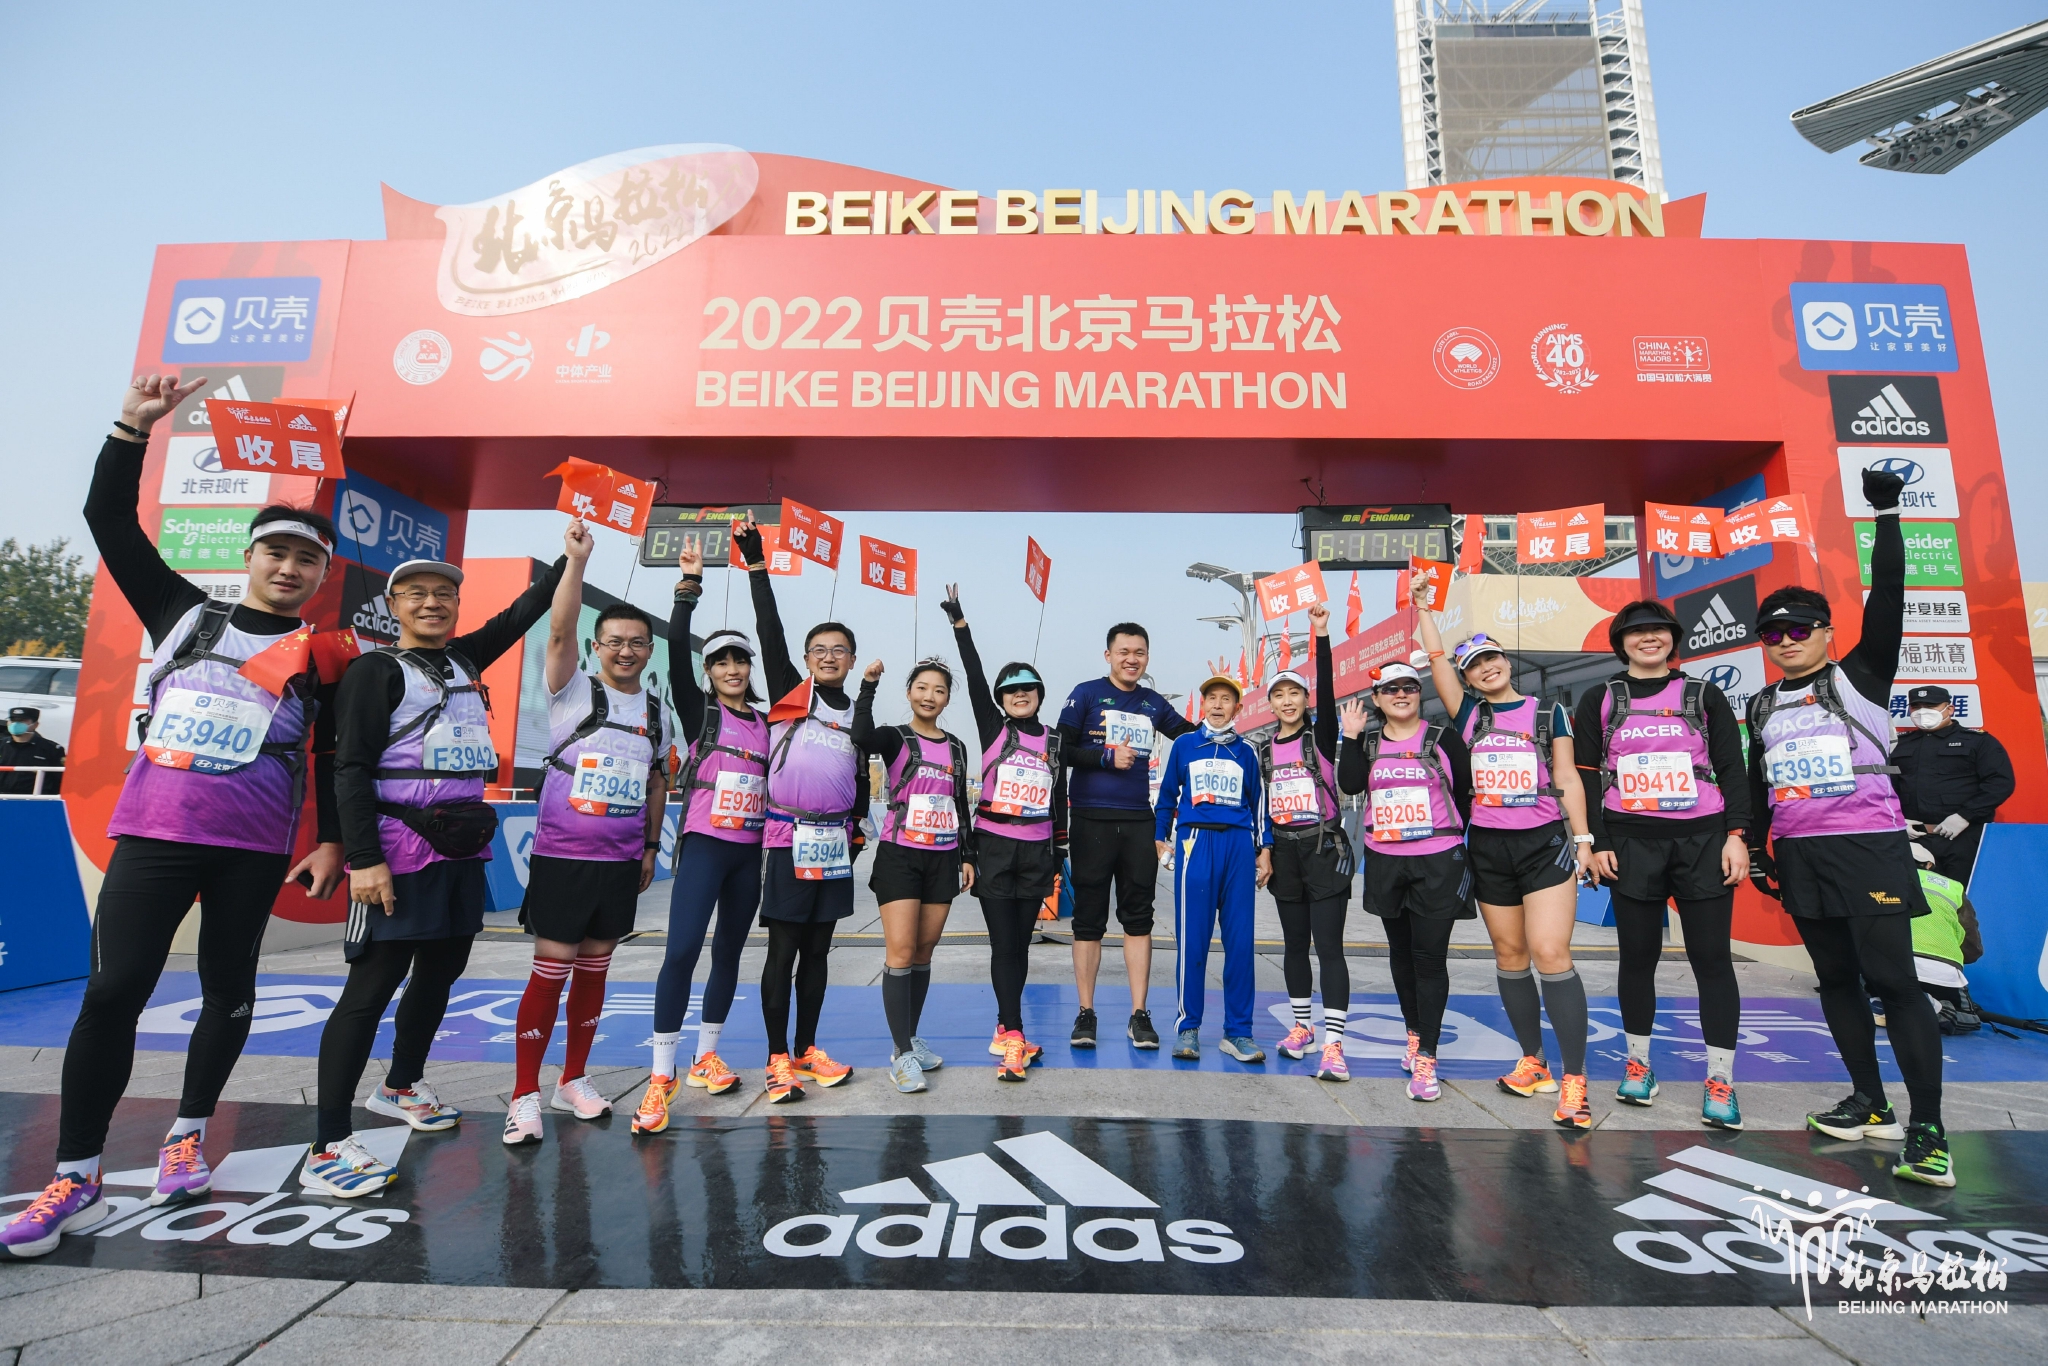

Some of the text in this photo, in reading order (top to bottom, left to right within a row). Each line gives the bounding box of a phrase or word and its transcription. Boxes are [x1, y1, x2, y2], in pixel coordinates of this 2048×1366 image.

[472, 162, 709, 274] 北京马拉松
[785, 188, 1665, 238] BEIKE BEIJING MARATHON
[231, 295, 311, 331] 贝壳
[700, 294, 1343, 354] 2022贝壳北京马拉松
[1864, 303, 1946, 340] 贝壳
[230, 333, 305, 343] 让家更美好
[1545, 333, 1583, 345] AIMS
[1638, 341, 1671, 350] CHINA
[1869, 341, 1947, 353] 让家更美好
[1530, 344, 1544, 374] WORLD
[1545, 344, 1585, 368] 40
[1639, 355, 1672, 363] MAJORS
[556, 364, 613, 378] 中体产业
[1636, 373, 1713, 383] 中国马拉松大满贯
[695, 370, 1347, 410] BEIKE BEIJING MARATHON
[287, 423, 318, 432] adidas
[1851, 416, 1931, 436] adidas
[234, 434, 325, 471] 收尾
[181, 478, 250, 494] 北京现代
[163, 518, 250, 535] Schneider
[1359, 507, 1411, 525] FENGMAO
[199, 534, 248, 544] Electric
[387, 509, 442, 561] 贝壳
[1656, 527, 1712, 553] 收尾
[1729, 517, 1800, 545] 收尾
[1859, 532, 1953, 549] Seider
[788, 526, 832, 563] 收尾
[1317, 532, 1442, 562] 6:17:46
[1528, 532, 1591, 559] 收尾
[868, 561, 907, 591] 收尾
[1863, 563, 1959, 575] 施德电气
[197, 584, 242, 598] 夏基金
[1269, 584, 1318, 615] 收尾
[1903, 602, 1962, 616] 华夏基金
[1688, 623, 1748, 650] adidas
[1922, 665, 1968, 674] JEWELLERY
[157, 713, 253, 754] F3940
[804, 729, 858, 756] PACE
[1111, 724, 1149, 744] F2967
[1475, 735, 1528, 748] PACER
[1620, 724, 1684, 742] PACER
[433, 746, 495, 770] F3942
[584, 734, 651, 760] PACER
[918, 767, 954, 783] PACE
[1272, 767, 1308, 781] ACER
[1373, 767, 1427, 781] PACER
[1475, 769, 1532, 790] E9206
[1772, 755, 1844, 784] F3935
[579, 773, 641, 800] F3943
[999, 780, 1048, 806] E9202
[1194, 773, 1238, 793] E0606
[1622, 771, 1691, 794] D9412
[719, 789, 764, 813] E9201
[912, 809, 955, 829] E9203
[1375, 803, 1427, 826] E9205
[797, 842, 845, 863] F3944
[764, 1203, 1245, 1263] adidas
[1614, 1219, 2048, 1276] adidas
